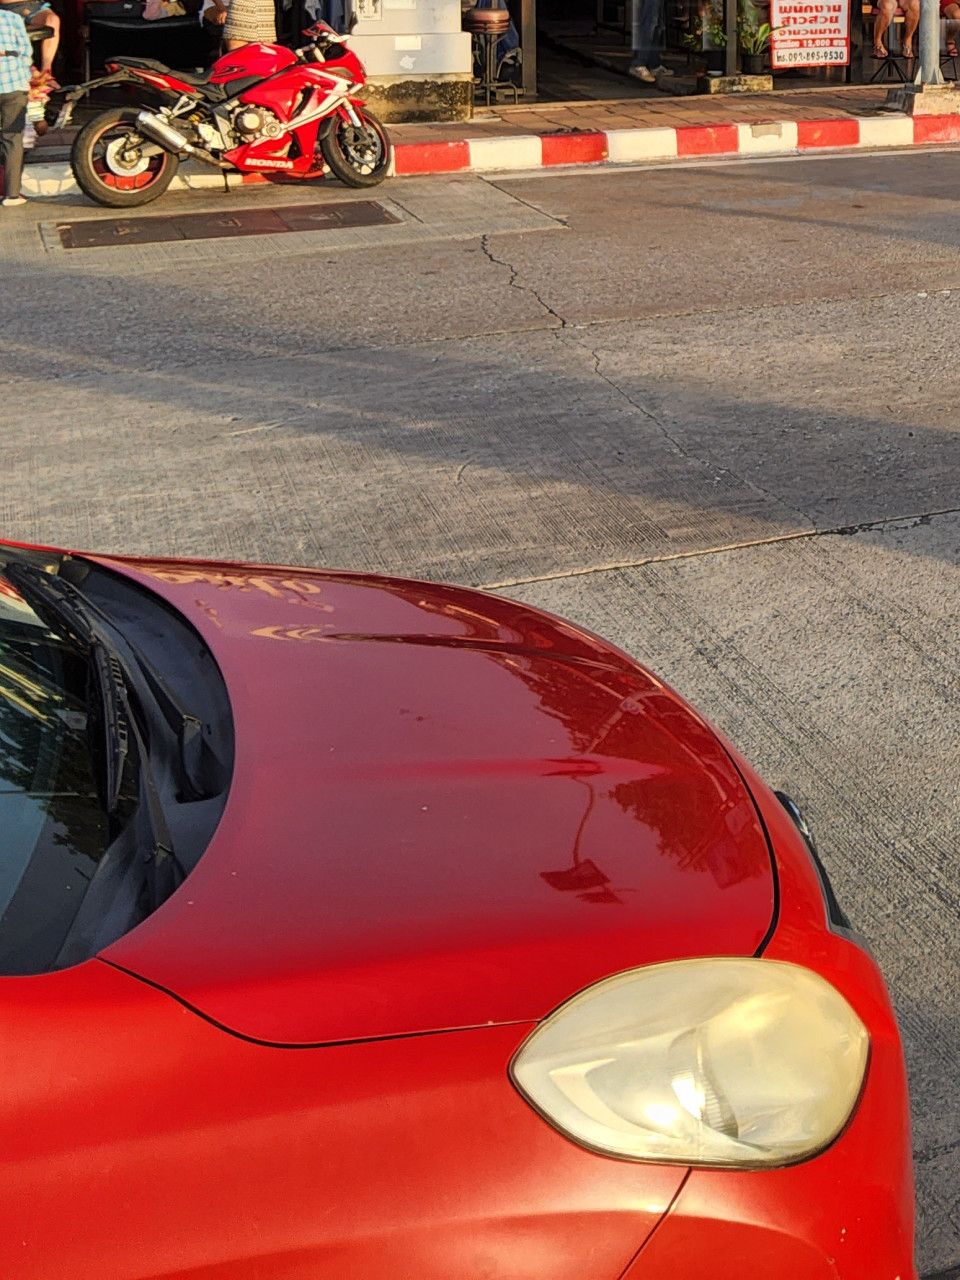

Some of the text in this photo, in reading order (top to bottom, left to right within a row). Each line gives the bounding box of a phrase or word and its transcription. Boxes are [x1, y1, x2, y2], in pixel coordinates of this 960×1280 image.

[778, 1, 842, 14] พนักงาน
[780, 15, 839, 26] สาวสวย
[245, 157, 293, 169] HONDA
